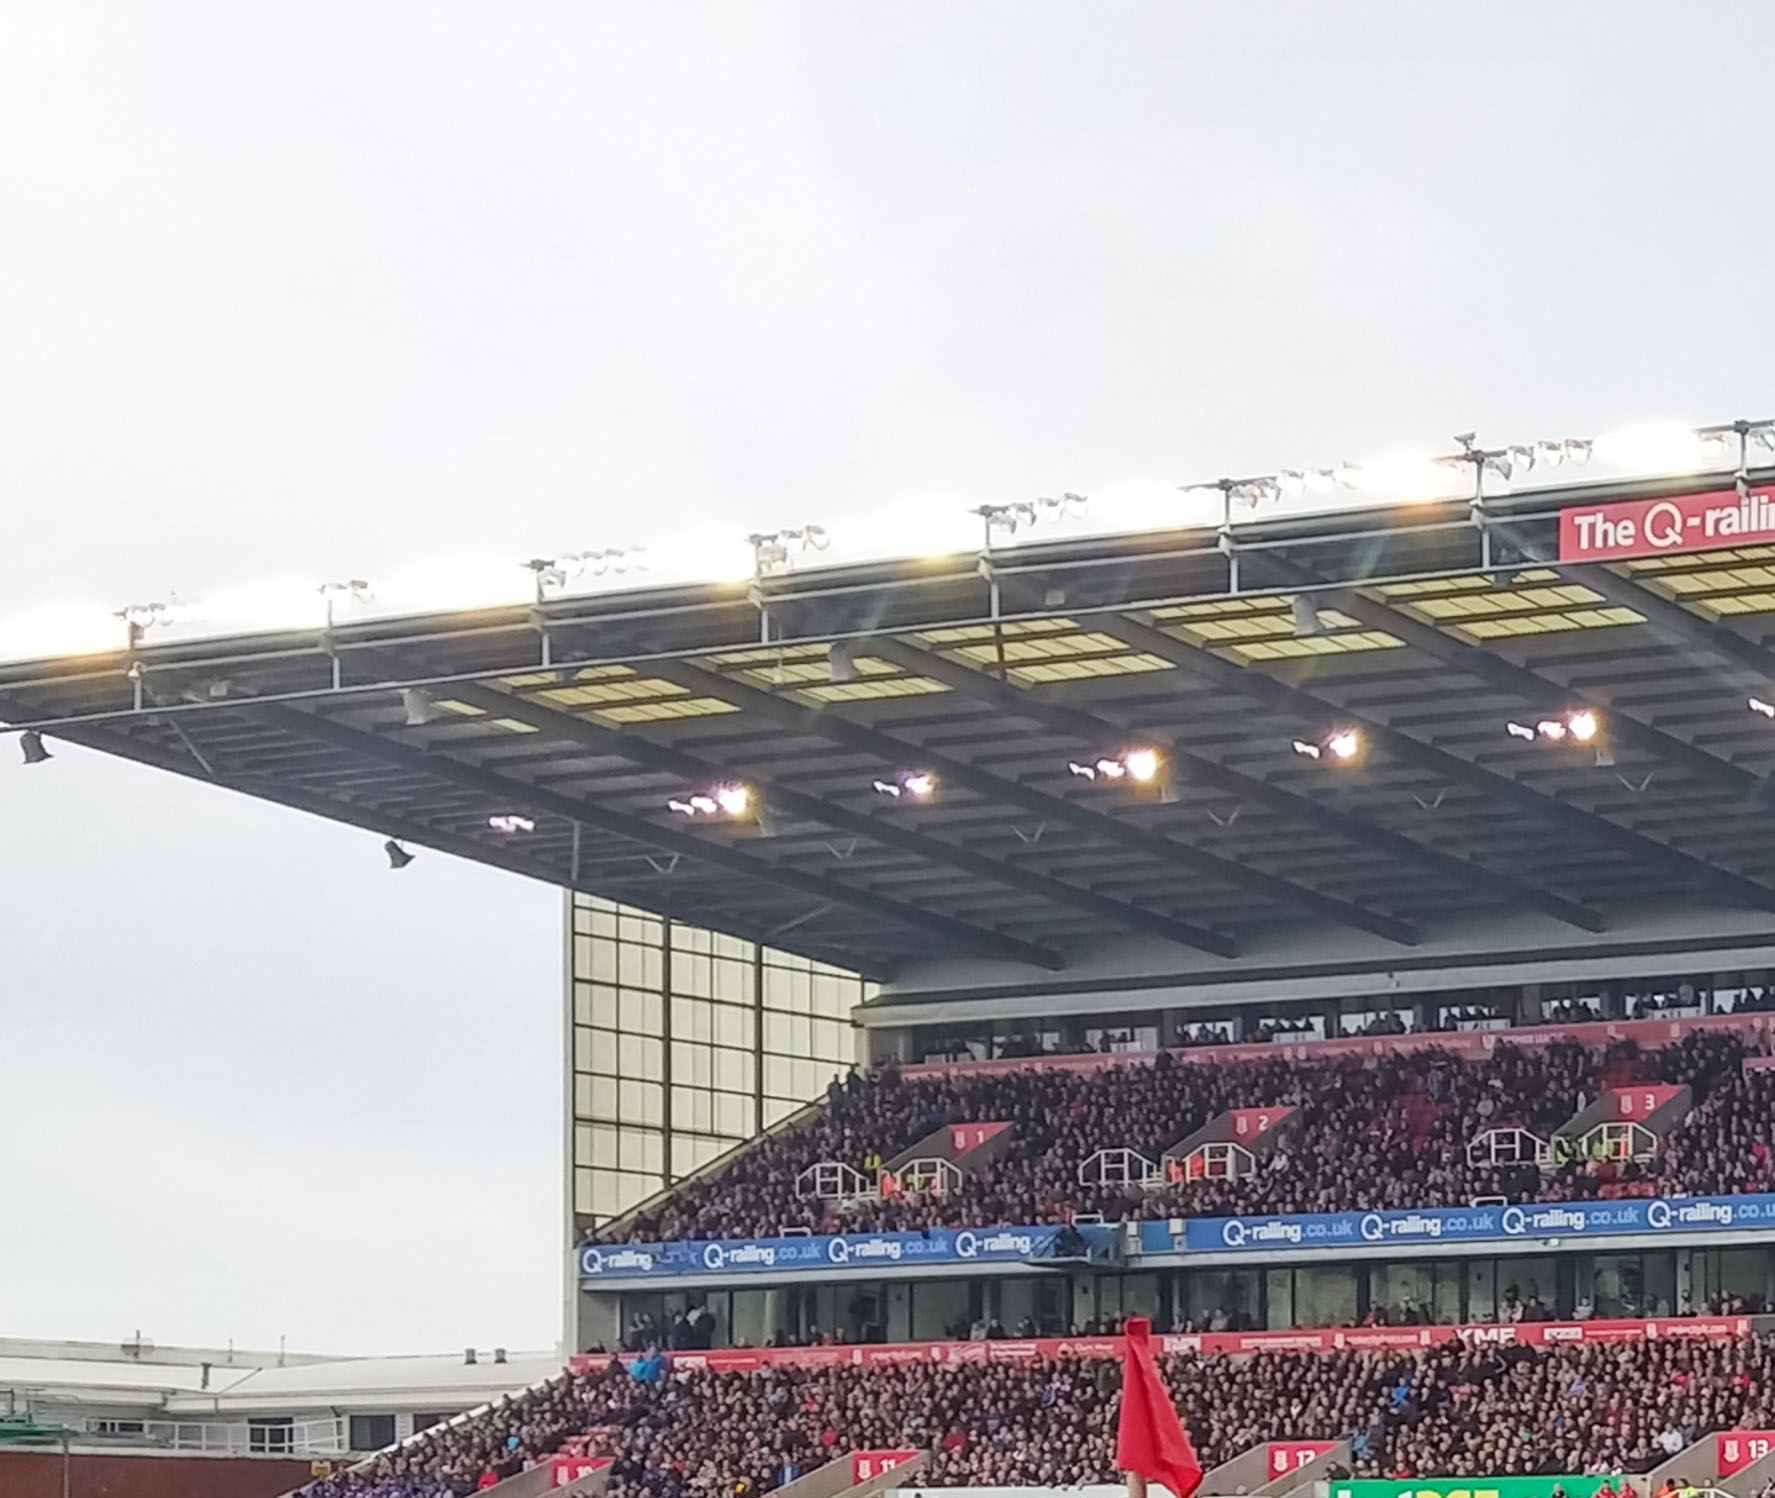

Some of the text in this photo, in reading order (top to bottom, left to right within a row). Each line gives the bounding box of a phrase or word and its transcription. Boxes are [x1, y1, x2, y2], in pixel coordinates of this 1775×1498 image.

[1574, 513, 1635, 551] The
[1645, 1094, 1656, 1110] 3
[976, 1130, 984, 1144] 1
[1258, 1115, 1269, 1131] 2
[1222, 1216, 1353, 1248] Q-railing.co.uk
[1361, 1211, 1494, 1242] Q-railing.co.uk
[1502, 1204, 1640, 1235] Q-railing.co.uk
[703, 1241, 821, 1271] Q-railing.co.uk
[828, 1235, 949, 1264] Q-railing.co.uk
[1748, 1439, 1769, 1459] 13
